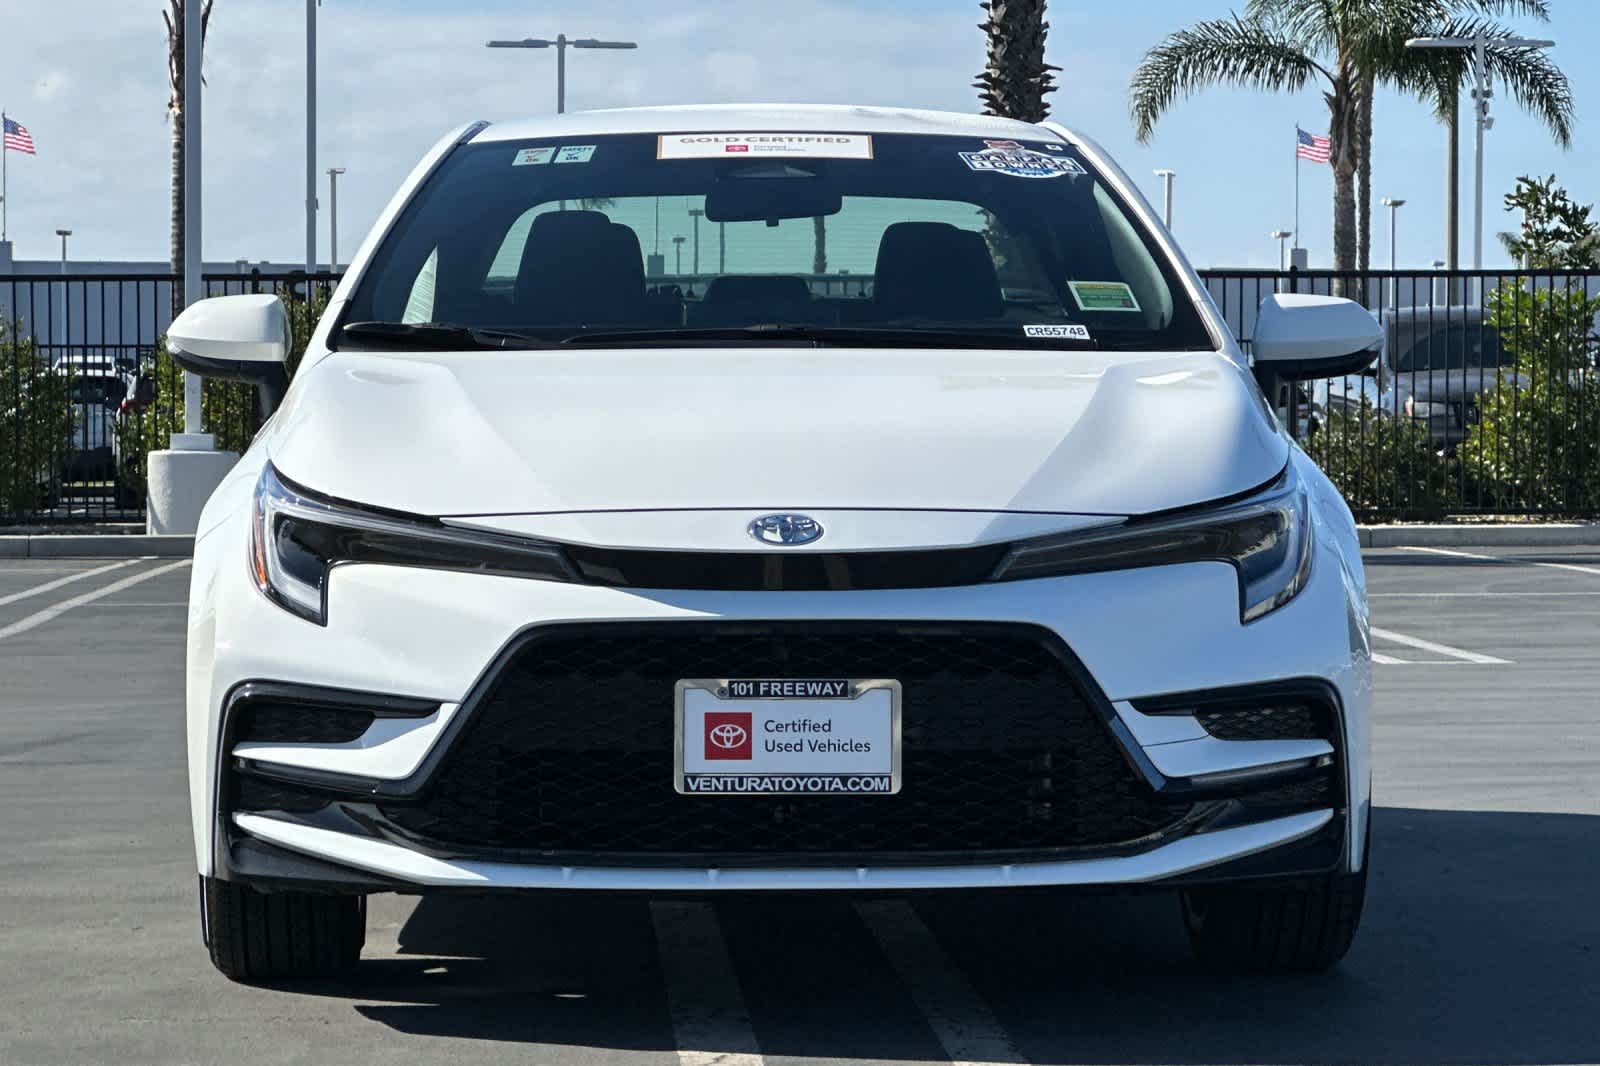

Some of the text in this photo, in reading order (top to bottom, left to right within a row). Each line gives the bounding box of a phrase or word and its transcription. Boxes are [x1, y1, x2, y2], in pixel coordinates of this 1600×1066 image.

[679, 136, 851, 144] GOLD CERTIFIED
[731, 682, 845, 696] 101 FREEWAY
[764, 719, 832, 733] Certified
[764, 739, 872, 753] Used Vehicles
[687, 777, 890, 791] VENTURATOYOTA.COM
